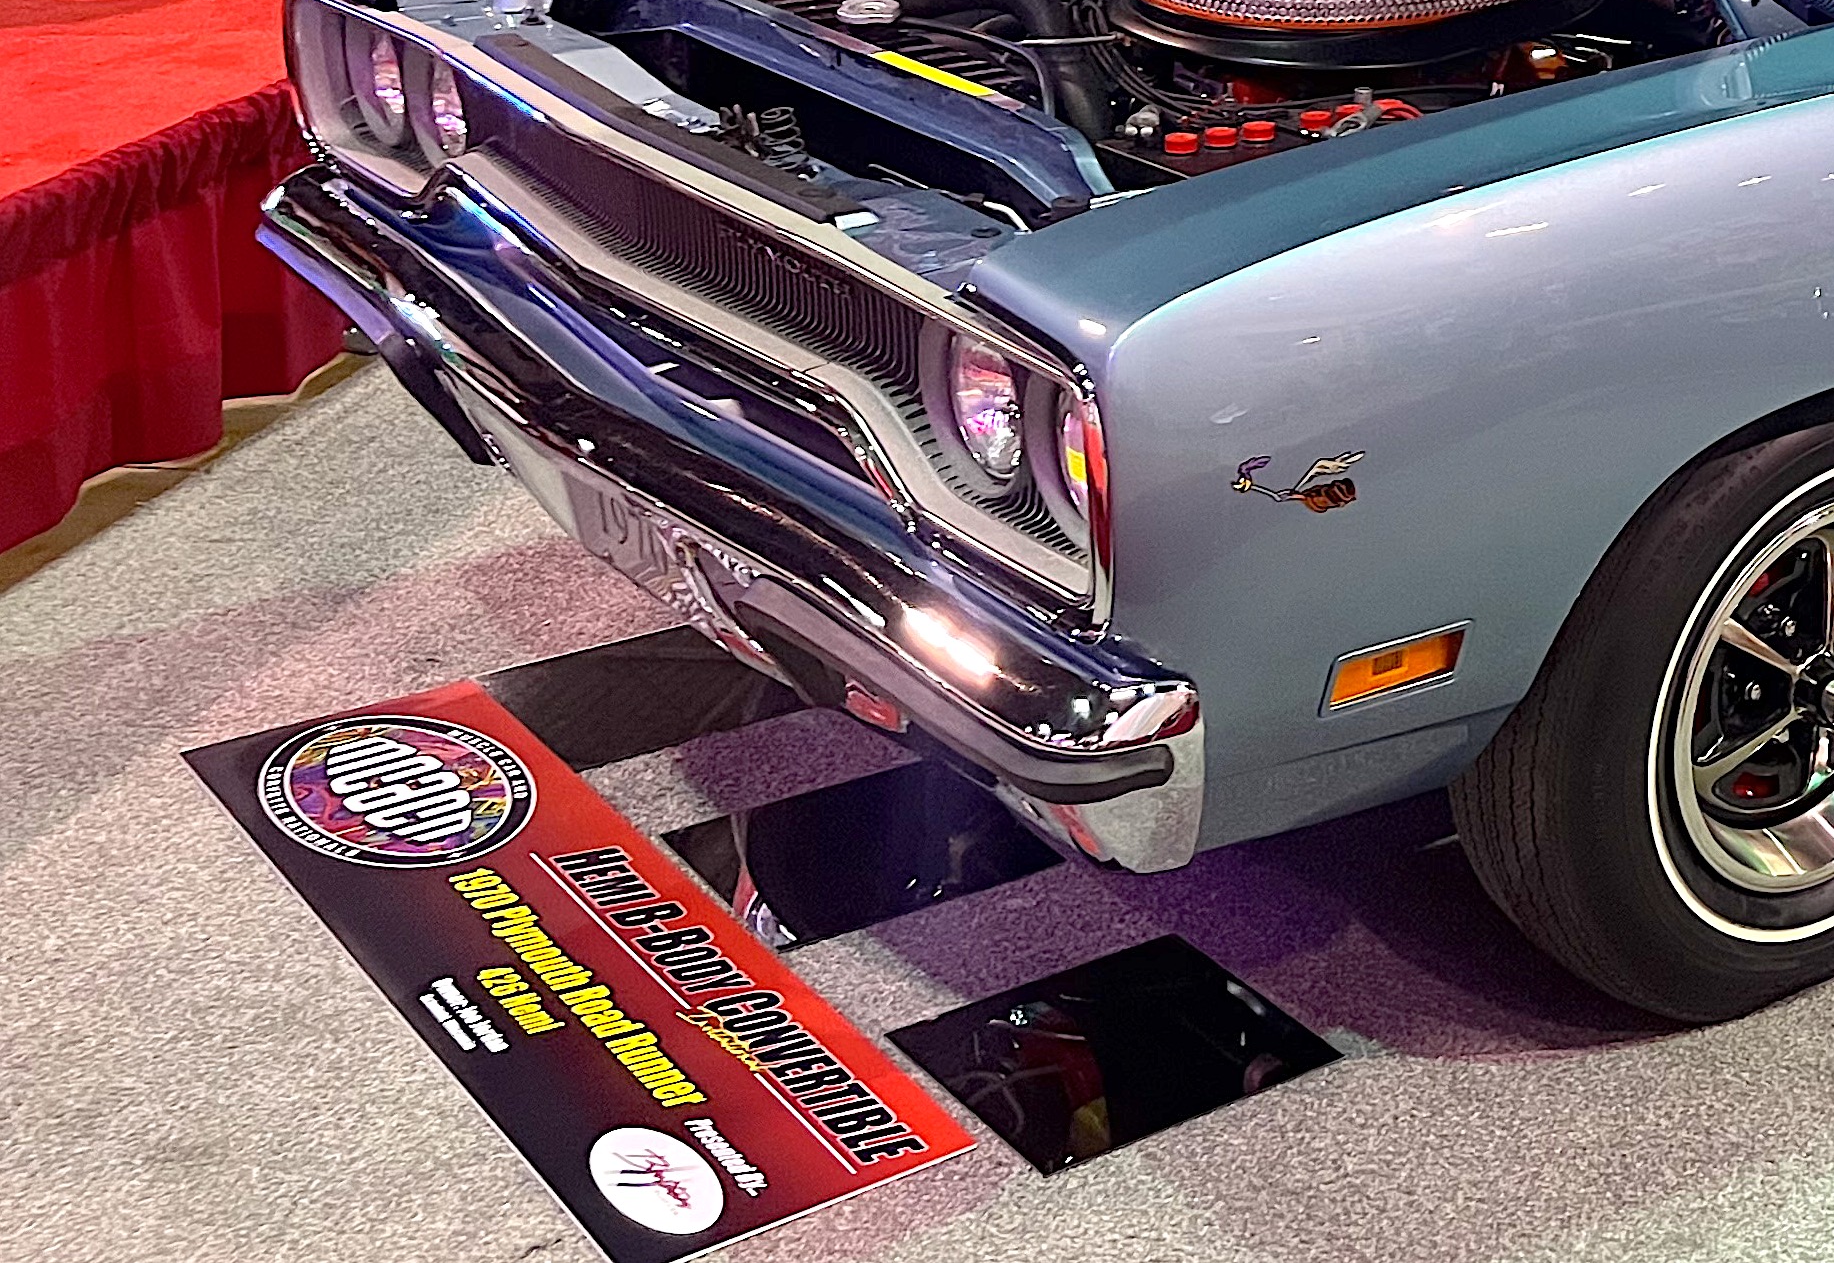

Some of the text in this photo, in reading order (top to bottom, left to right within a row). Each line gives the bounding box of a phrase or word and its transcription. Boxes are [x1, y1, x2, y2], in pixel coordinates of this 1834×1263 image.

[449, 868, 519, 910] 1970
[482, 906, 593, 991] Plymouth
[478, 967, 565, 1035] 426 Hemi
[563, 985, 640, 1038] Road
[610, 1034, 706, 1107] Runner
[684, 1118, 753, 1176] Presented
